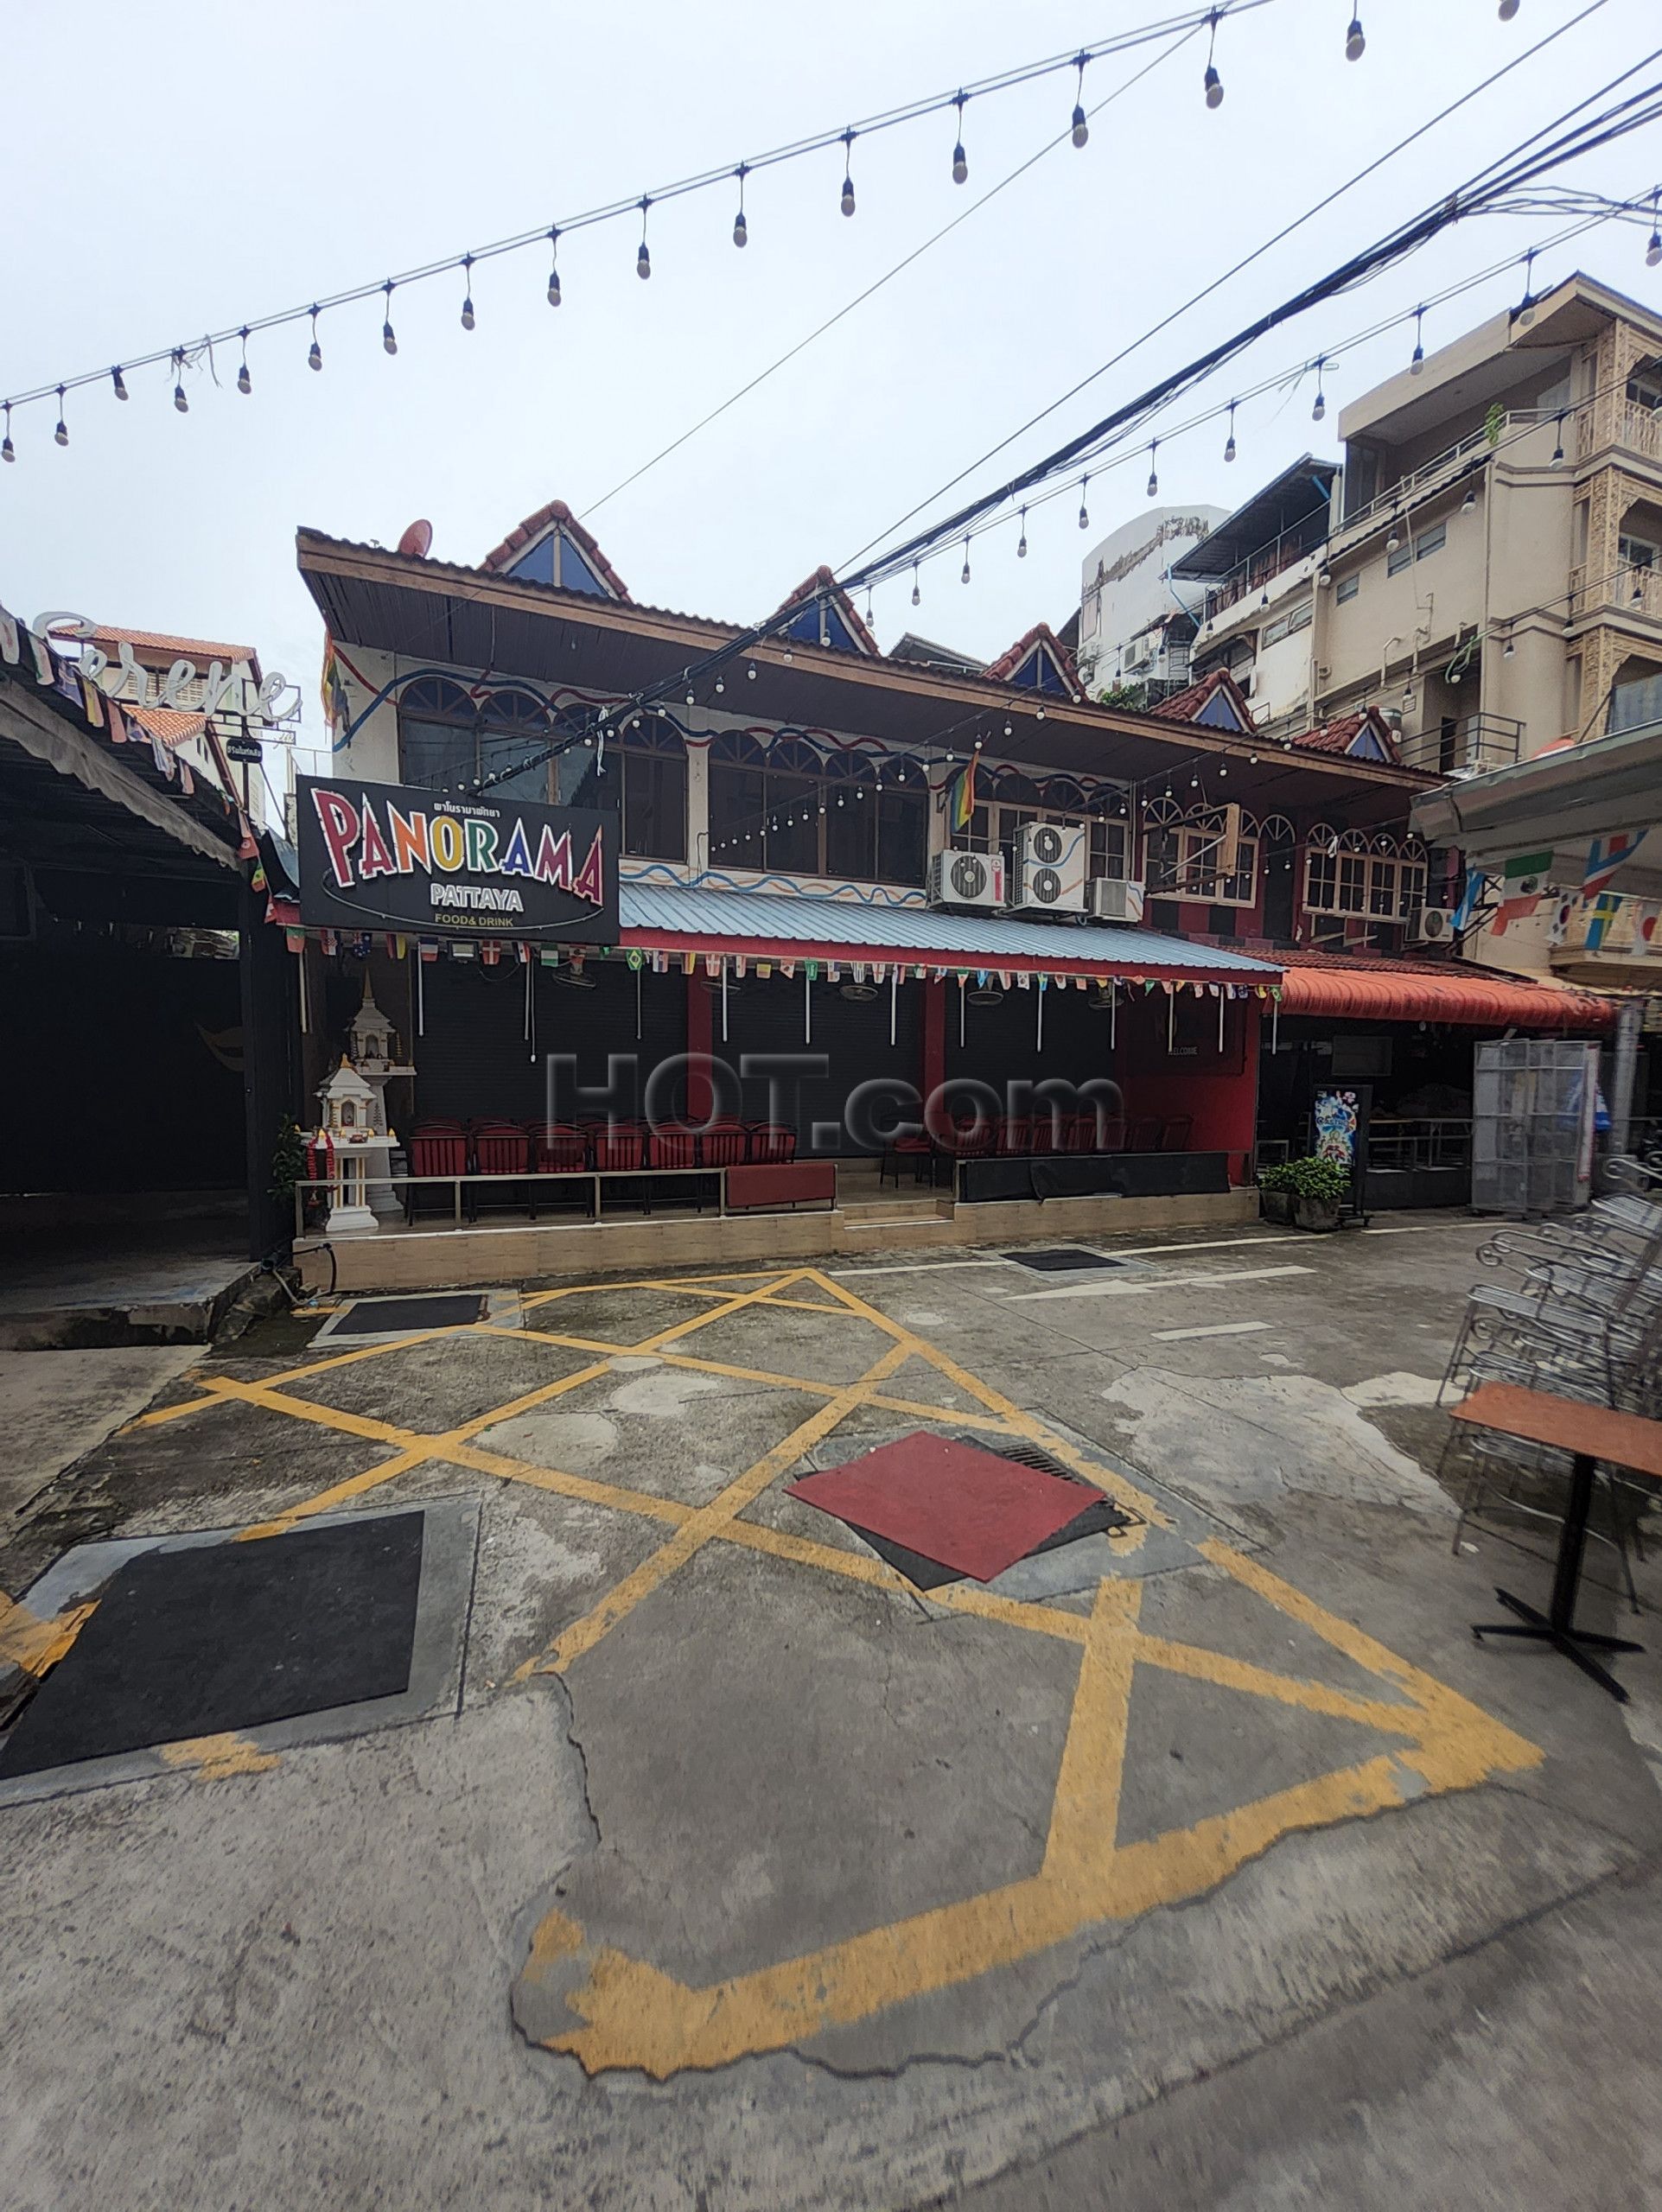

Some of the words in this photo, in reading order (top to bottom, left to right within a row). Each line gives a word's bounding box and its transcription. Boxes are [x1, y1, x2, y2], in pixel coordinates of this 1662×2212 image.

[310, 787, 603, 906] PANORAMA
[430, 882, 524, 912] PATTAYA
[478, 916, 514, 927] DRINK
[1168, 1046, 1199, 1056] ELCOME
